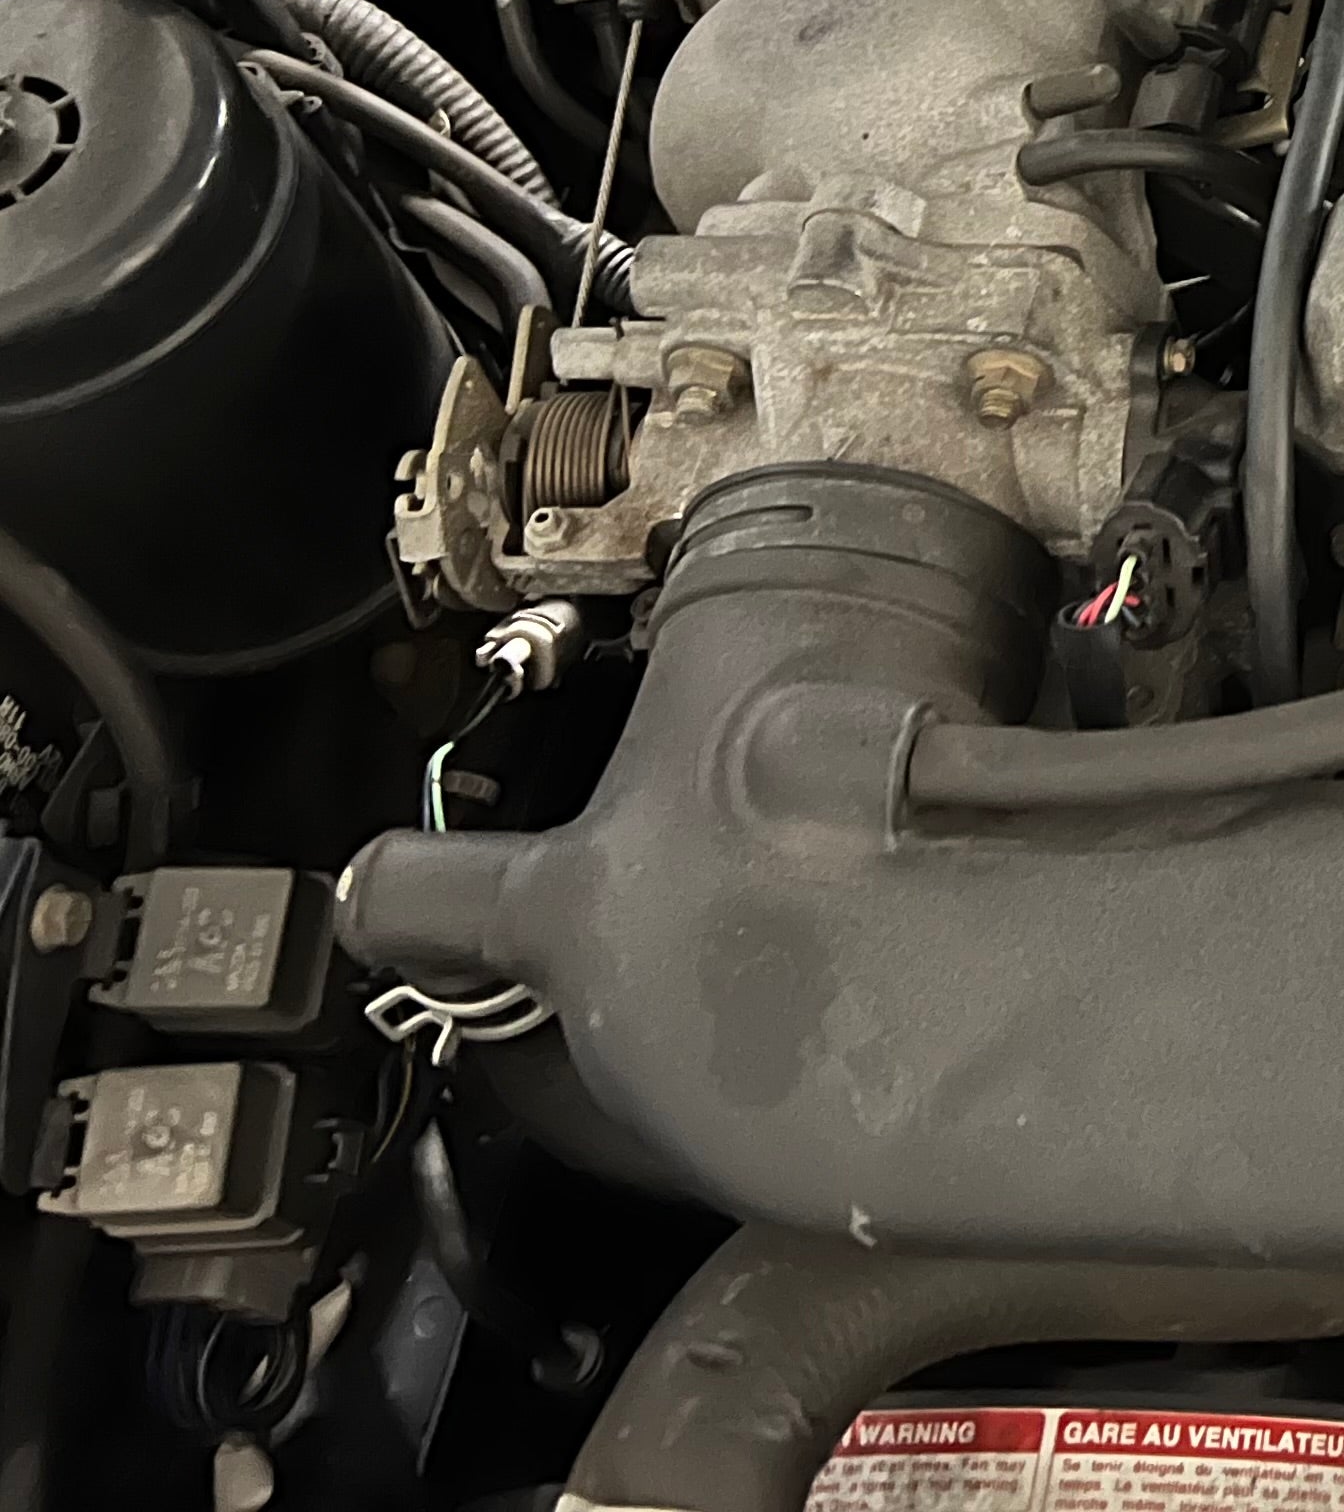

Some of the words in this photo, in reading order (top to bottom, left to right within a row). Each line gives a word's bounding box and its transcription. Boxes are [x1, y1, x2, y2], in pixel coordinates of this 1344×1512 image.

[858, 1420, 976, 1446] WARNING
[1063, 1420, 1137, 1446] GARE
[1142, 1423, 1181, 1448] AU
